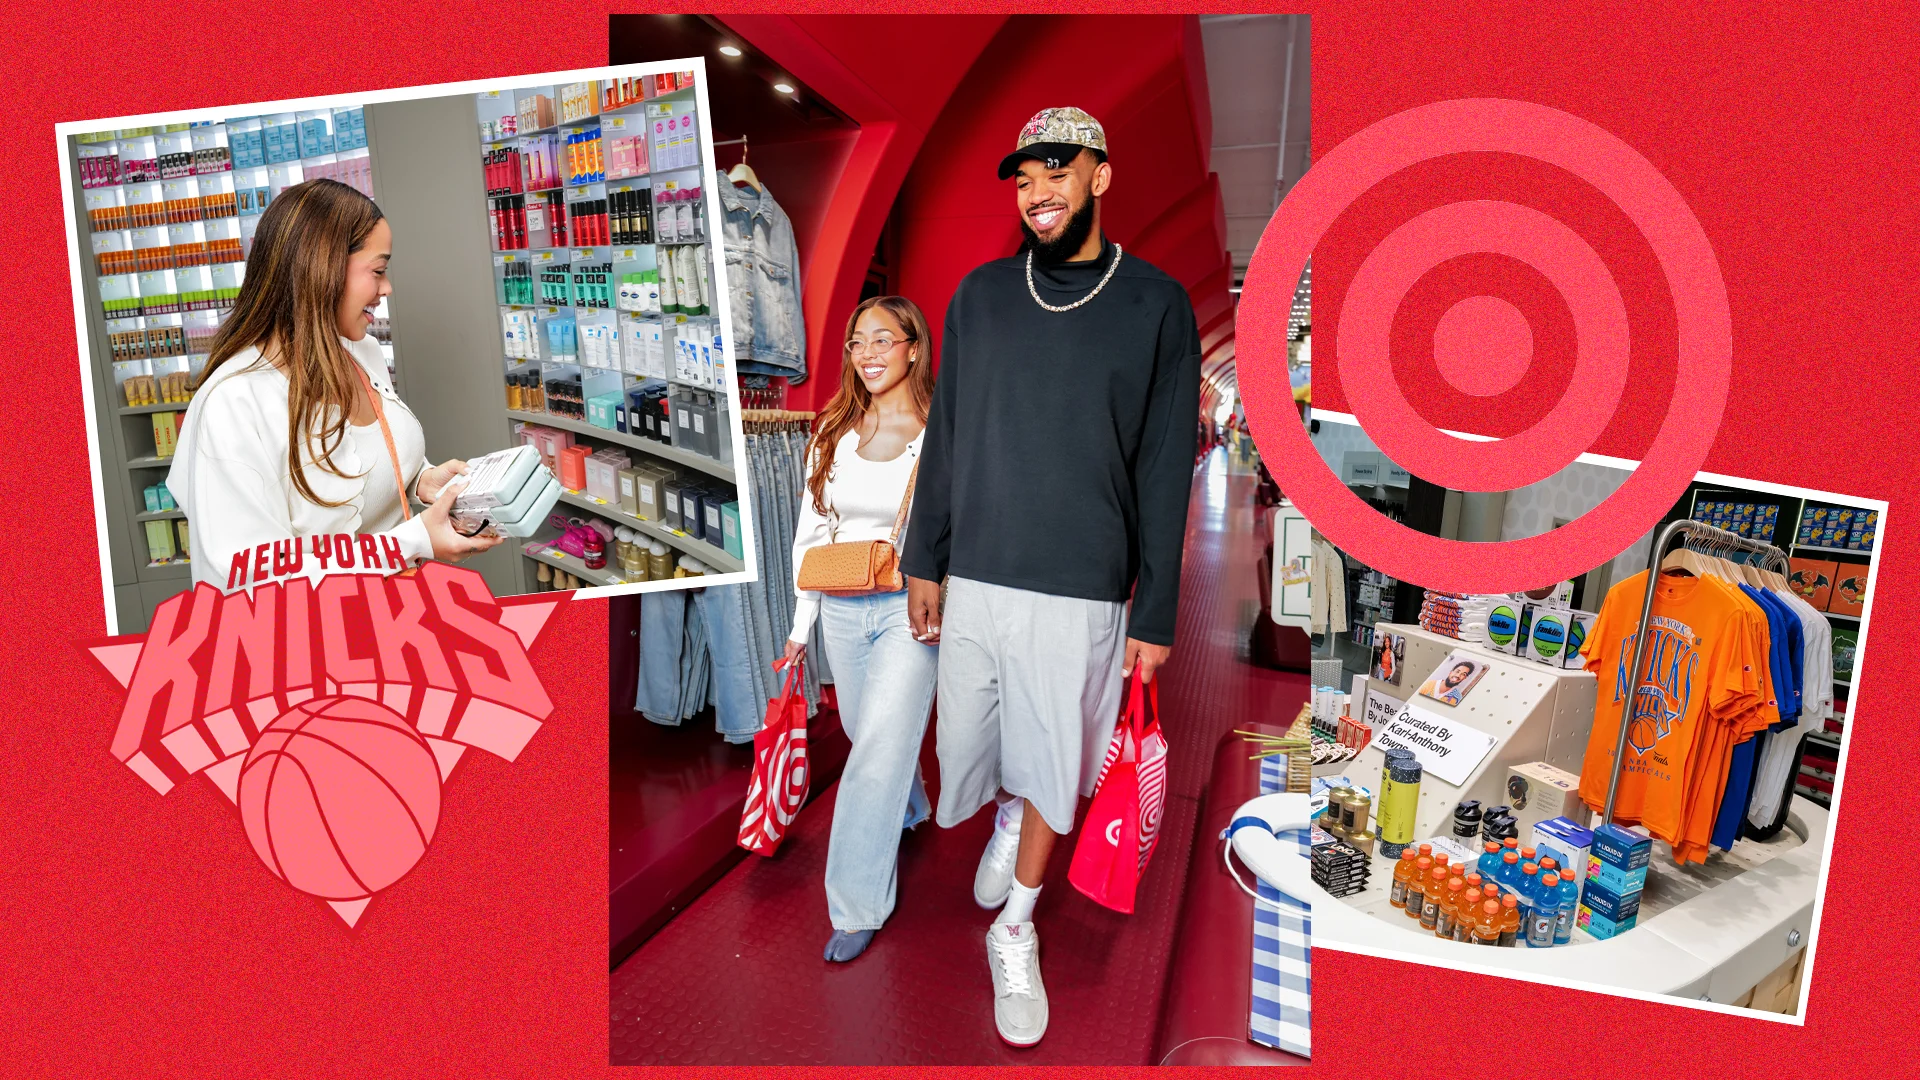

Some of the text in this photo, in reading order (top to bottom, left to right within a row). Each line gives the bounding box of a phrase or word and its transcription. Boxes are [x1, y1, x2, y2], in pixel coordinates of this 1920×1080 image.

[1489, 617, 1511, 630] Franklin
[1536, 623, 1563, 638] Franklin
[1666, 618, 1688, 636] YORK
[1613, 629, 1700, 723] KICKS
[1369, 697, 1383, 712] The
[1367, 709, 1390, 726] By Jo
[1399, 712, 1453, 742] Curated By
[1388, 722, 1452, 758] Karl-Anthony
[1628, 757, 1647, 767] NBA
[1331, 843, 1356, 856] UNO
[1535, 919, 1550, 934] G
